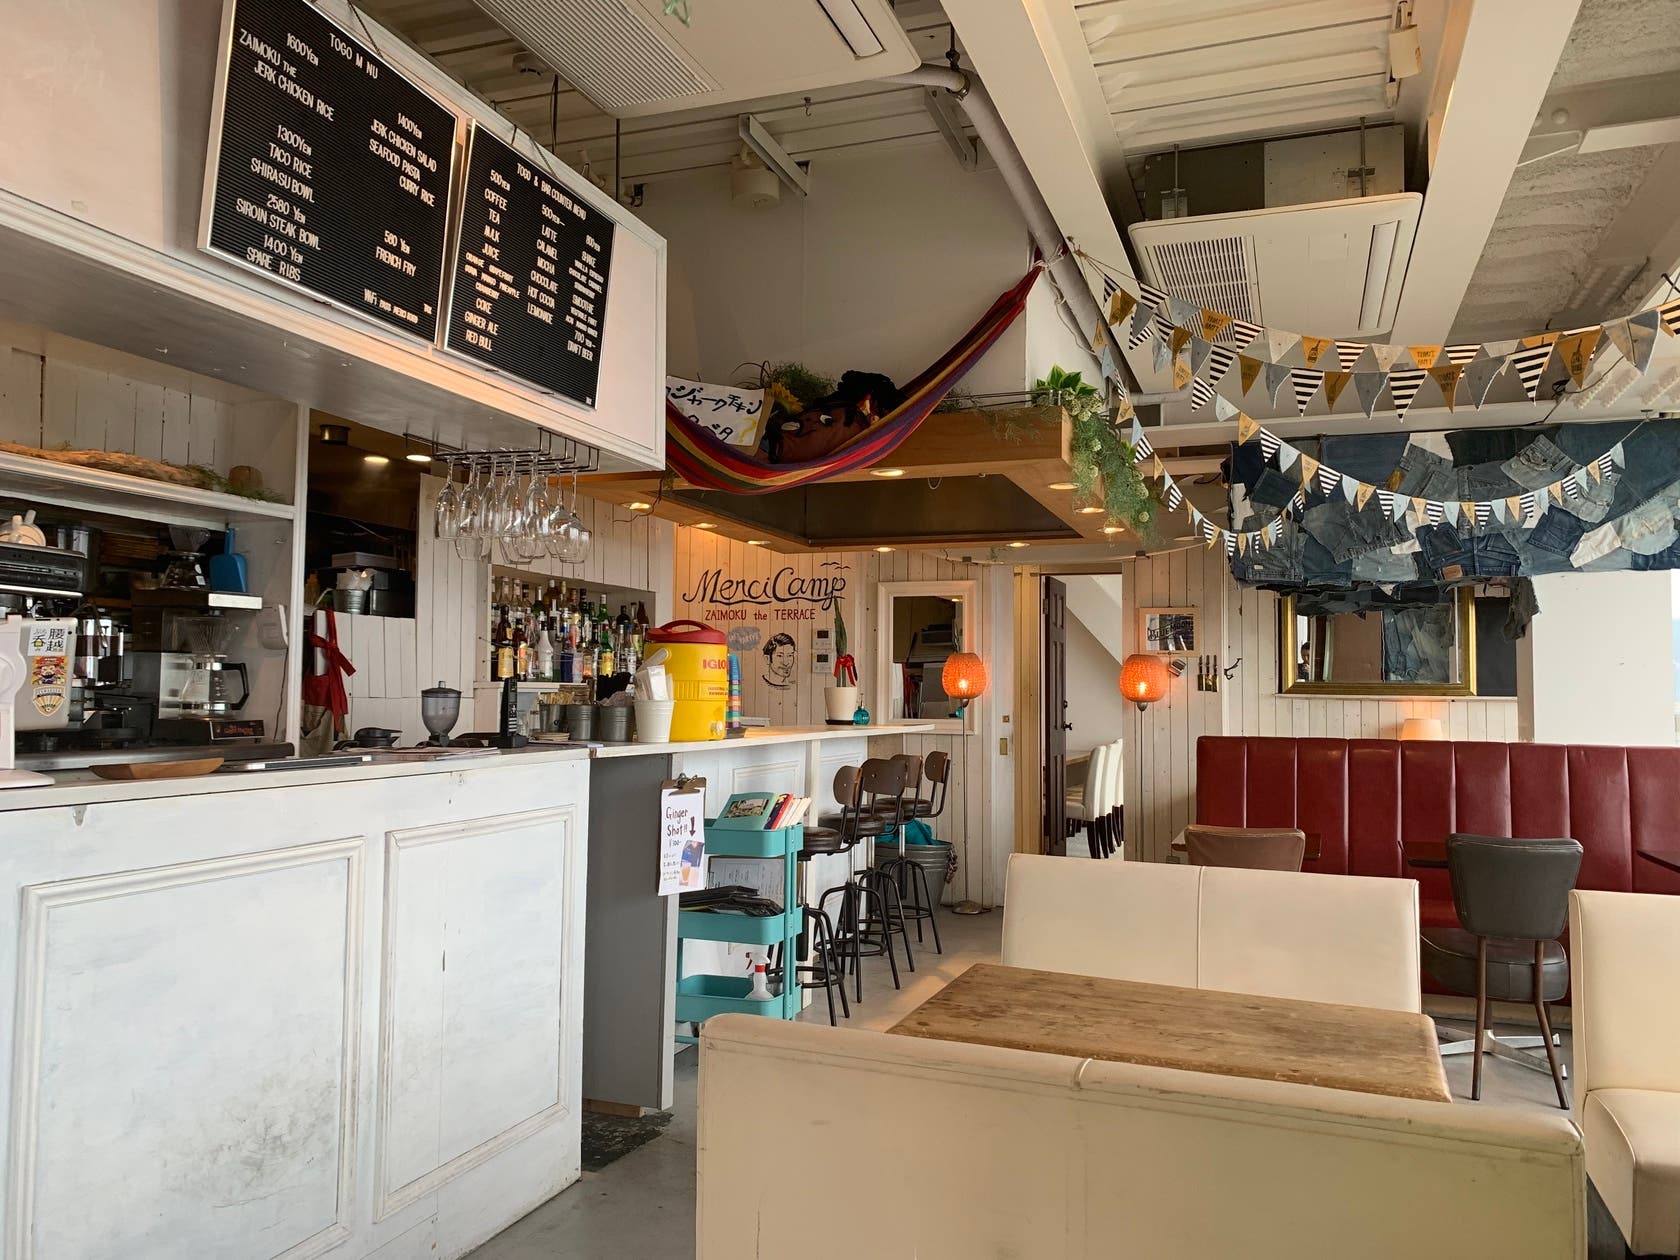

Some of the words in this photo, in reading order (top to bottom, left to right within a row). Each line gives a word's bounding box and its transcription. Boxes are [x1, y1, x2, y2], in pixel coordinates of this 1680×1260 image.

[240, 28, 280, 66] ZAIMOKU
[283, 60, 297, 78] THE
[329, 33, 352, 60] TOGO
[254, 60, 276, 84] JERK
[278, 74, 314, 108] CHICKEN
[316, 99, 334, 121] RICE
[371, 118, 388, 139] JERK
[388, 130, 416, 158] CHICKEN
[417, 150, 436, 172] SALAD
[269, 142, 290, 166] TACO
[293, 157, 312, 178] RICE
[369, 138, 400, 167] SEAFOOD
[402, 160, 420, 181] PASTA
[250, 158, 291, 188] SHIRASU
[291, 179, 315, 203] BOWL
[400, 176, 420, 196] CURRY
[420, 188, 436, 207] RICE
[517, 163, 531, 181] TOGO
[534, 176, 538, 186] &
[541, 180, 552, 196] BAR
[552, 188, 572, 211] COUNTER
[573, 203, 587, 220] MENU
[267, 194, 290, 214] 2580
[484, 188, 508, 210] COFFEE
[236, 198, 267, 224] SIROIN
[269, 214, 296, 238] STEAK
[299, 228, 321, 250] BOWL
[488, 208, 500, 224] TEA
[264, 234, 287, 256] 1400
[484, 224, 500, 242] MILK
[542, 224, 558, 242] LATTE
[376, 246, 402, 270] FRENCH
[402, 260, 416, 276] FRY
[482, 242, 500, 260] JUICE
[246, 246, 274, 270] SPARE
[280, 261, 300, 282] RIBS
[537, 256, 554, 275] MOCHA
[530, 270, 558, 294] CHOCOLATE
[476, 298, 492, 314] COKE
[528, 285, 538, 299] HOT
[539, 292, 555, 309] COCOA
[464, 311, 486, 330] GINGER
[487, 321, 499, 336] ALE
[528, 302, 554, 324] LEMONADE
[466, 329, 478, 344] RED
[478, 335, 492, 351] BULL
[705, 610, 747, 620] ZAIMOKU
[753, 610, 768, 620] the
[774, 609, 816, 620] TERRACE
[666, 806, 688, 824] Ginger
